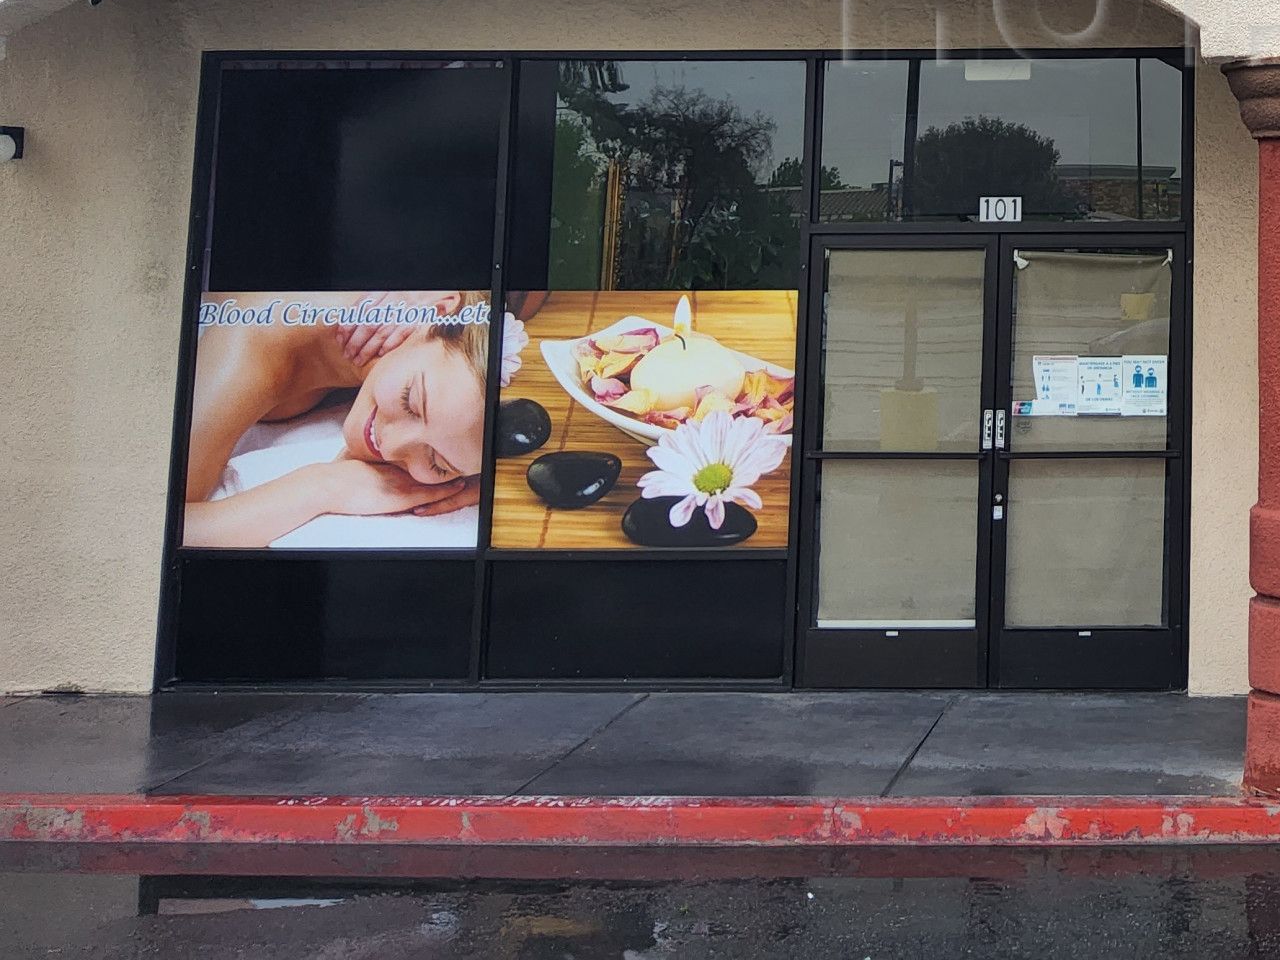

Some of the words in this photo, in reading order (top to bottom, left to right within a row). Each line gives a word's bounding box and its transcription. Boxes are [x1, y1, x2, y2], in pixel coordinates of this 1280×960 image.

[984, 198, 1017, 221] 101
[200, 300, 280, 326] Blood
[283, 299, 491, 326] Circulation...et
